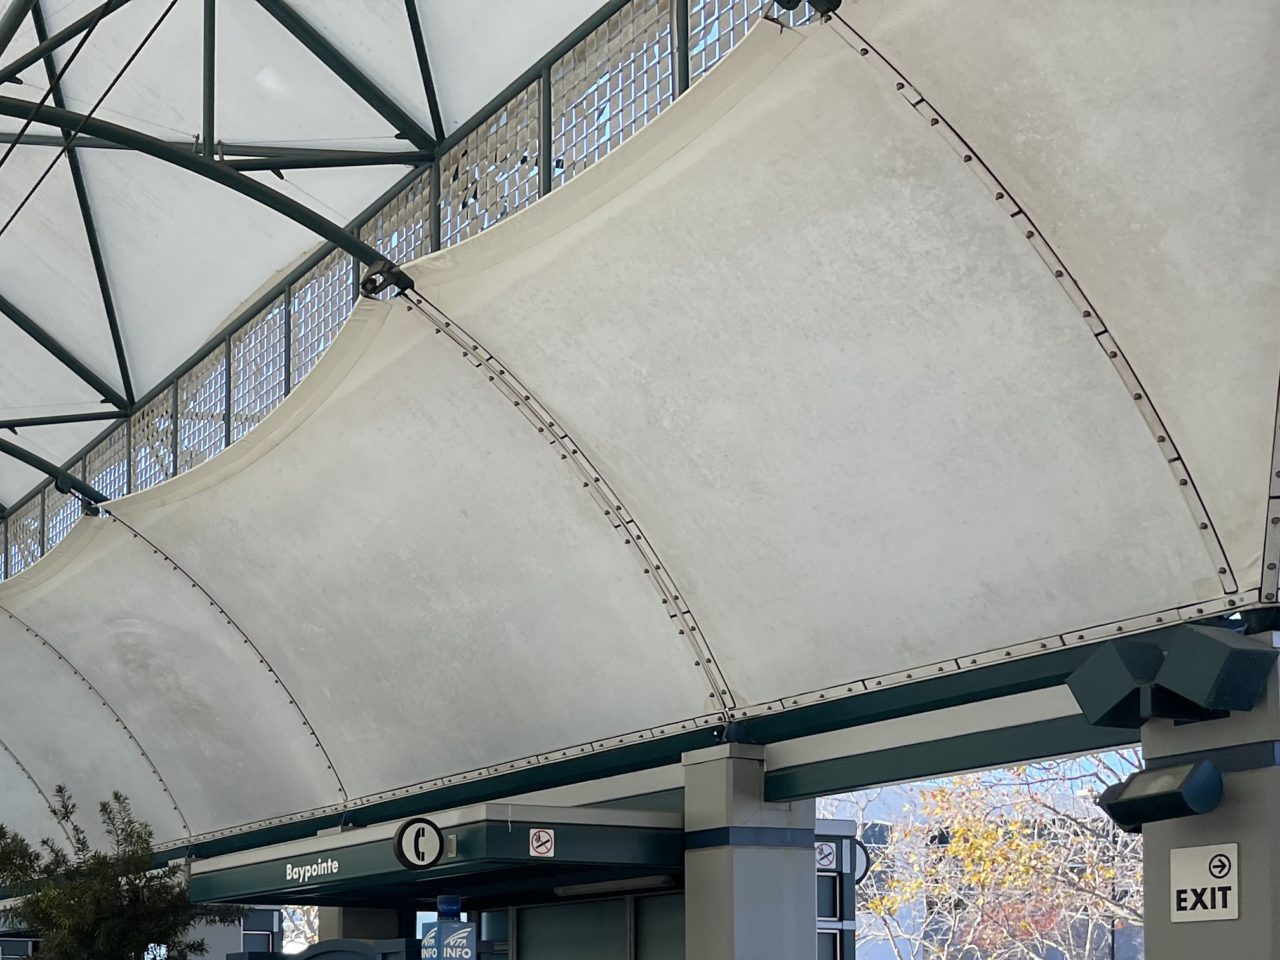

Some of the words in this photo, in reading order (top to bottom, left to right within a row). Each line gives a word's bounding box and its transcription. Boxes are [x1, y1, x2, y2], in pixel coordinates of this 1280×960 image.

[286, 857, 339, 882] Baypointe
[1176, 885, 1232, 912] EXIT
[421, 948, 438, 959] INFO
[443, 947, 472, 959] INFO
